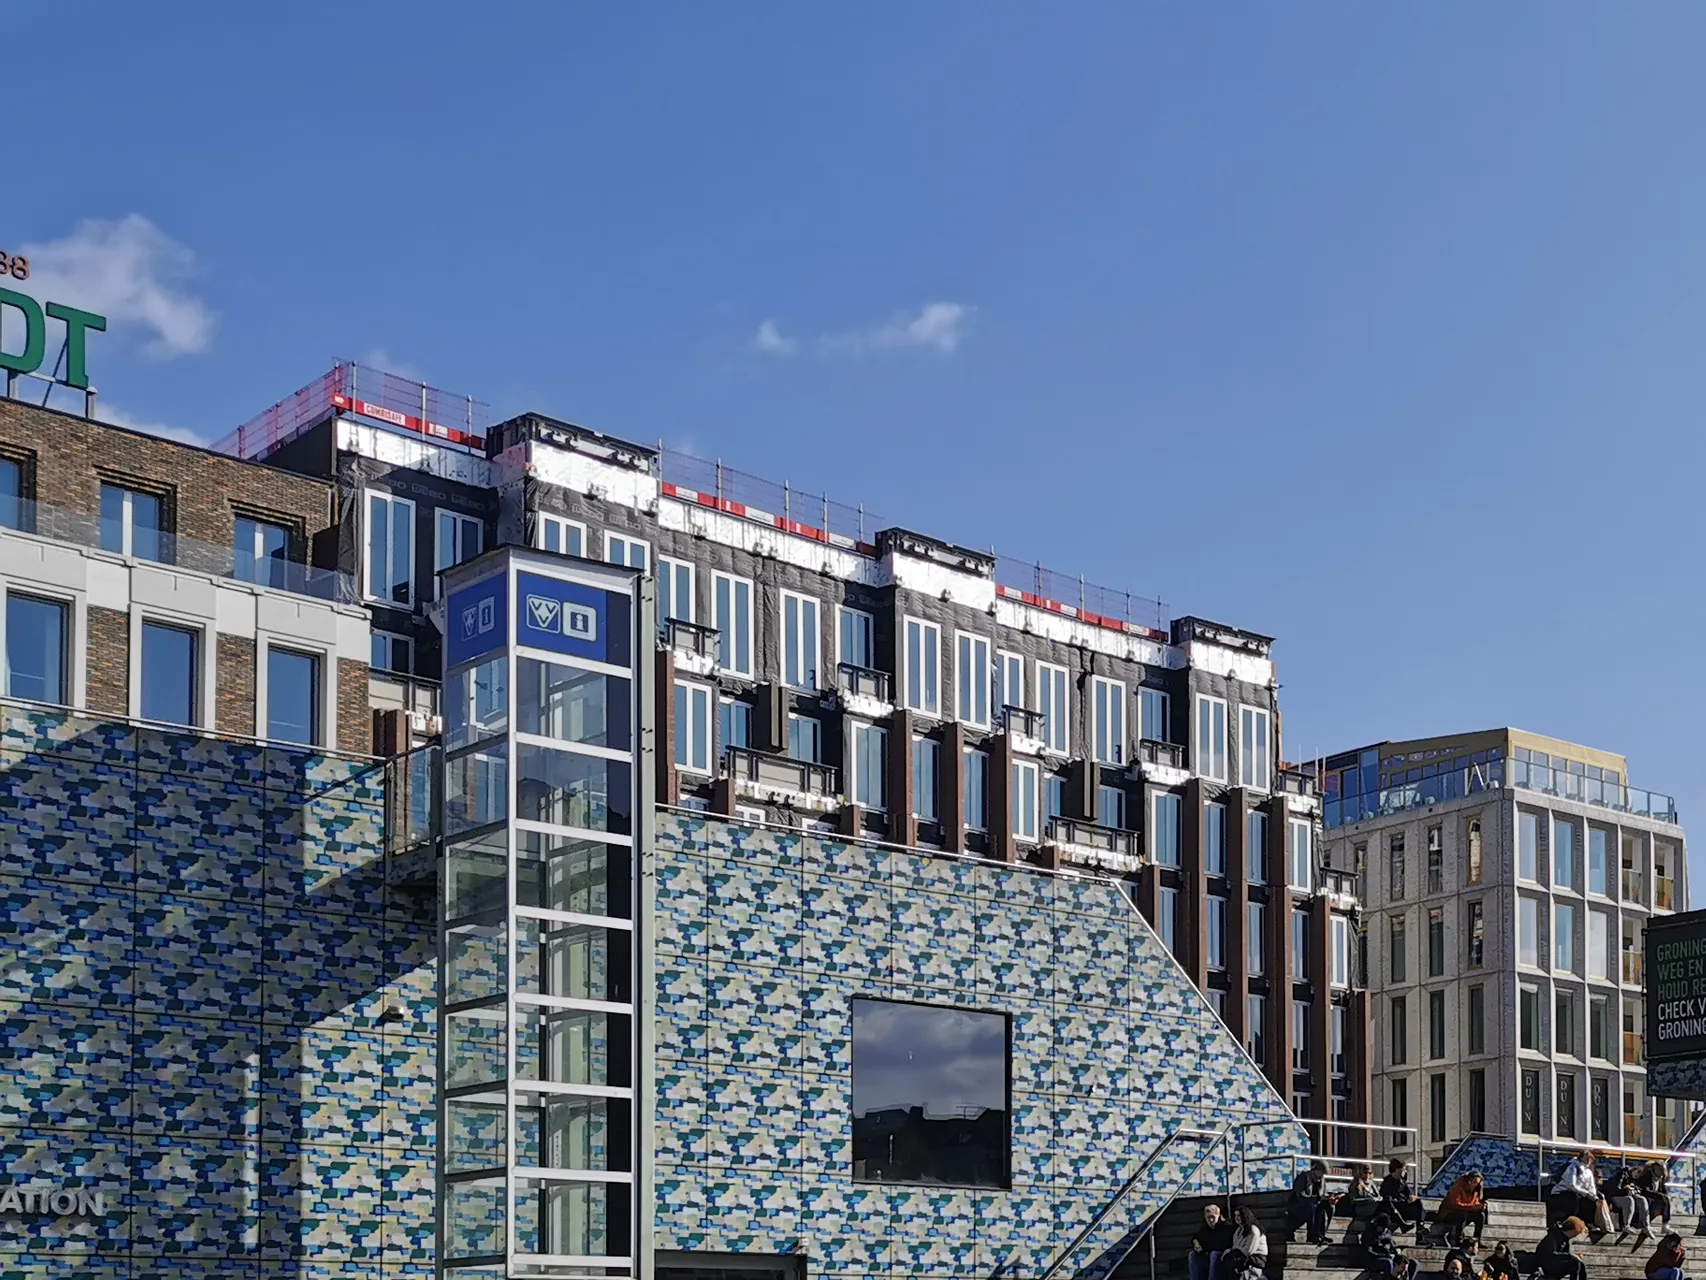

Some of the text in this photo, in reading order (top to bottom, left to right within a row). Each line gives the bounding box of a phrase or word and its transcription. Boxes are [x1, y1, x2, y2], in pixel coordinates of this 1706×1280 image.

[1657, 962, 1684, 981] WEG
[1688, 957, 1703, 977] EN
[1657, 980, 1689, 1001] HOUD
[1657, 999, 1695, 1021] CHECK
[0, 1186, 106, 1217] ATION
